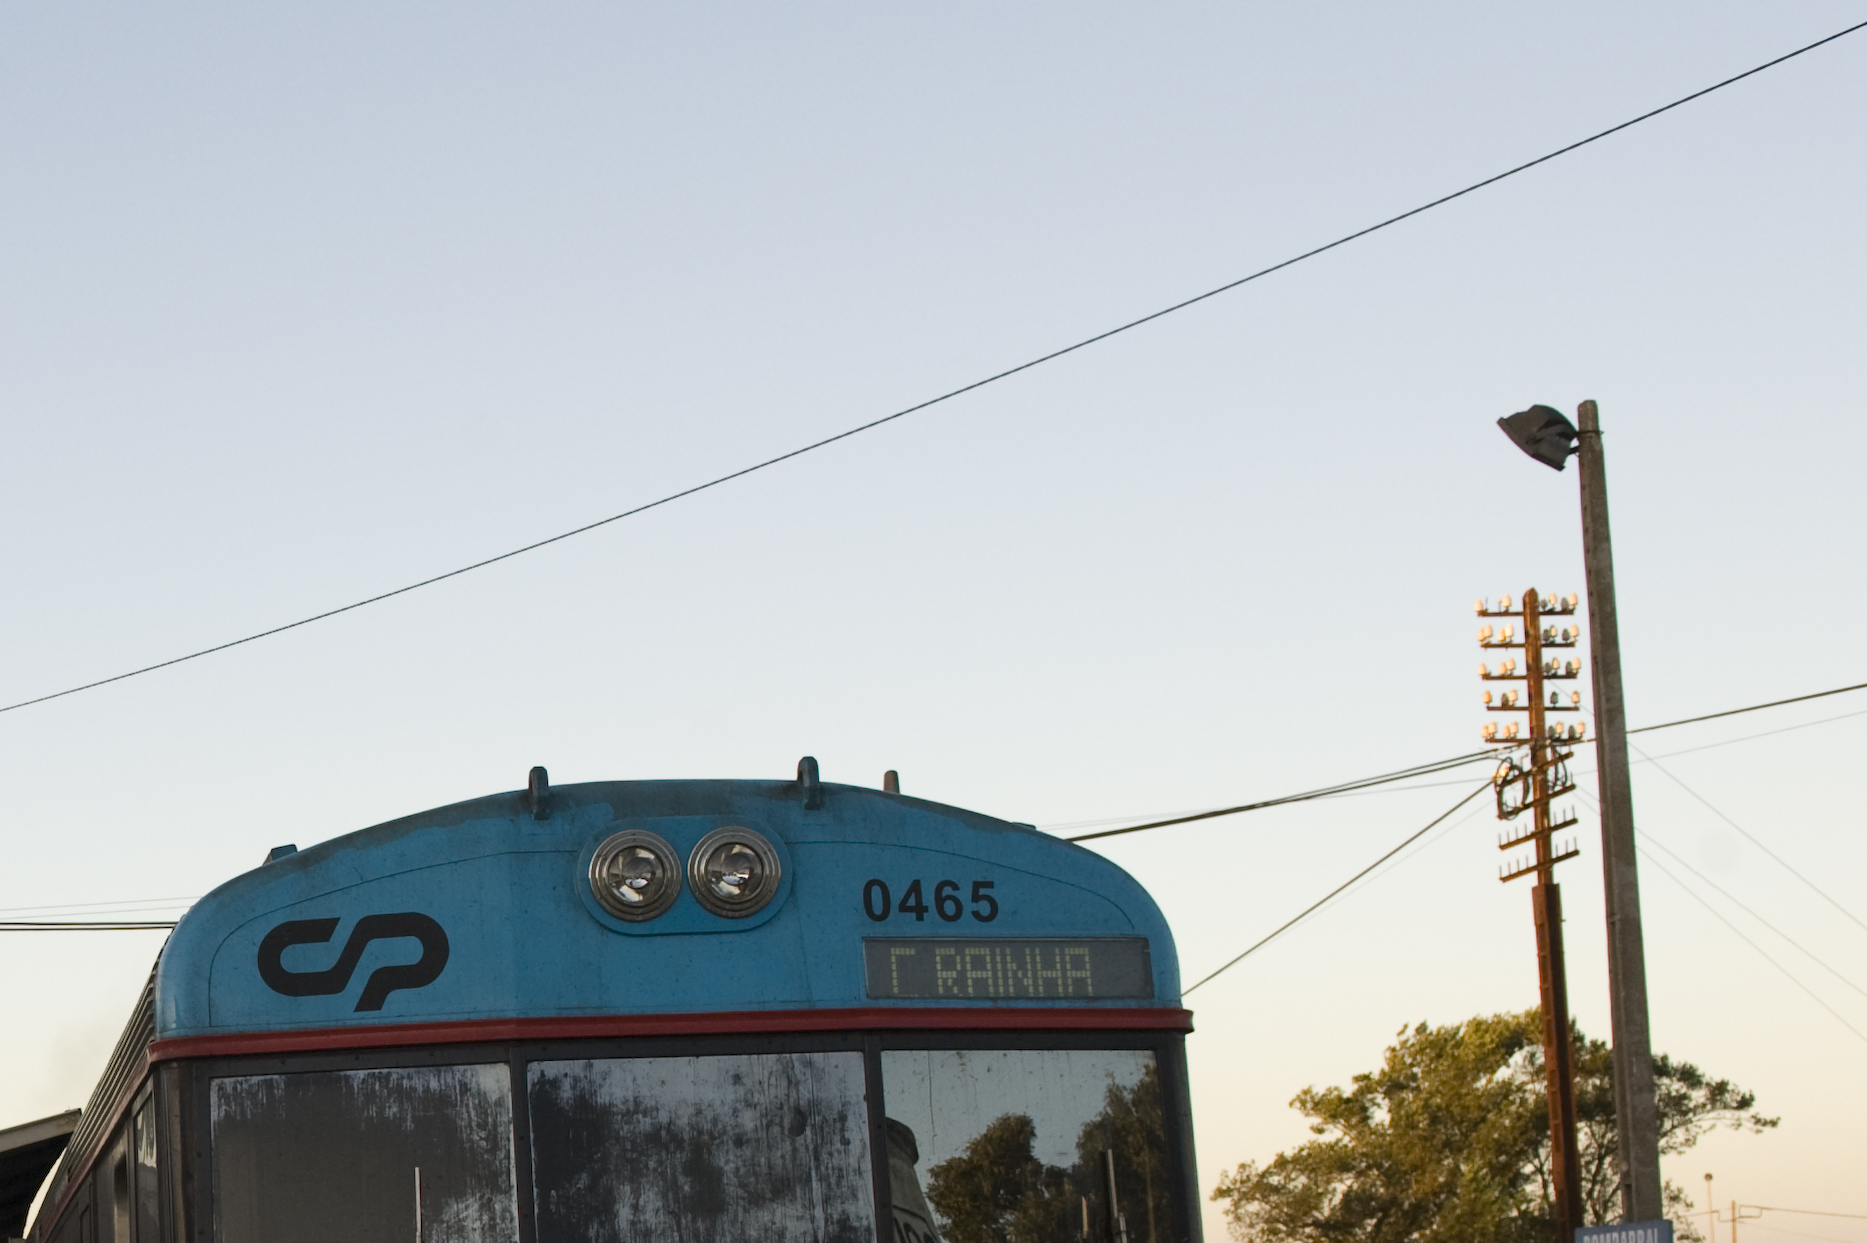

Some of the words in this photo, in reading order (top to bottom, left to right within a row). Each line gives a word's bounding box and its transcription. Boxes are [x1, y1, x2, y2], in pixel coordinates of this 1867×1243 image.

[863, 879, 998, 922] 0465
[257, 912, 449, 1012] CP
[935, 948, 1093, 997] RAINHA
